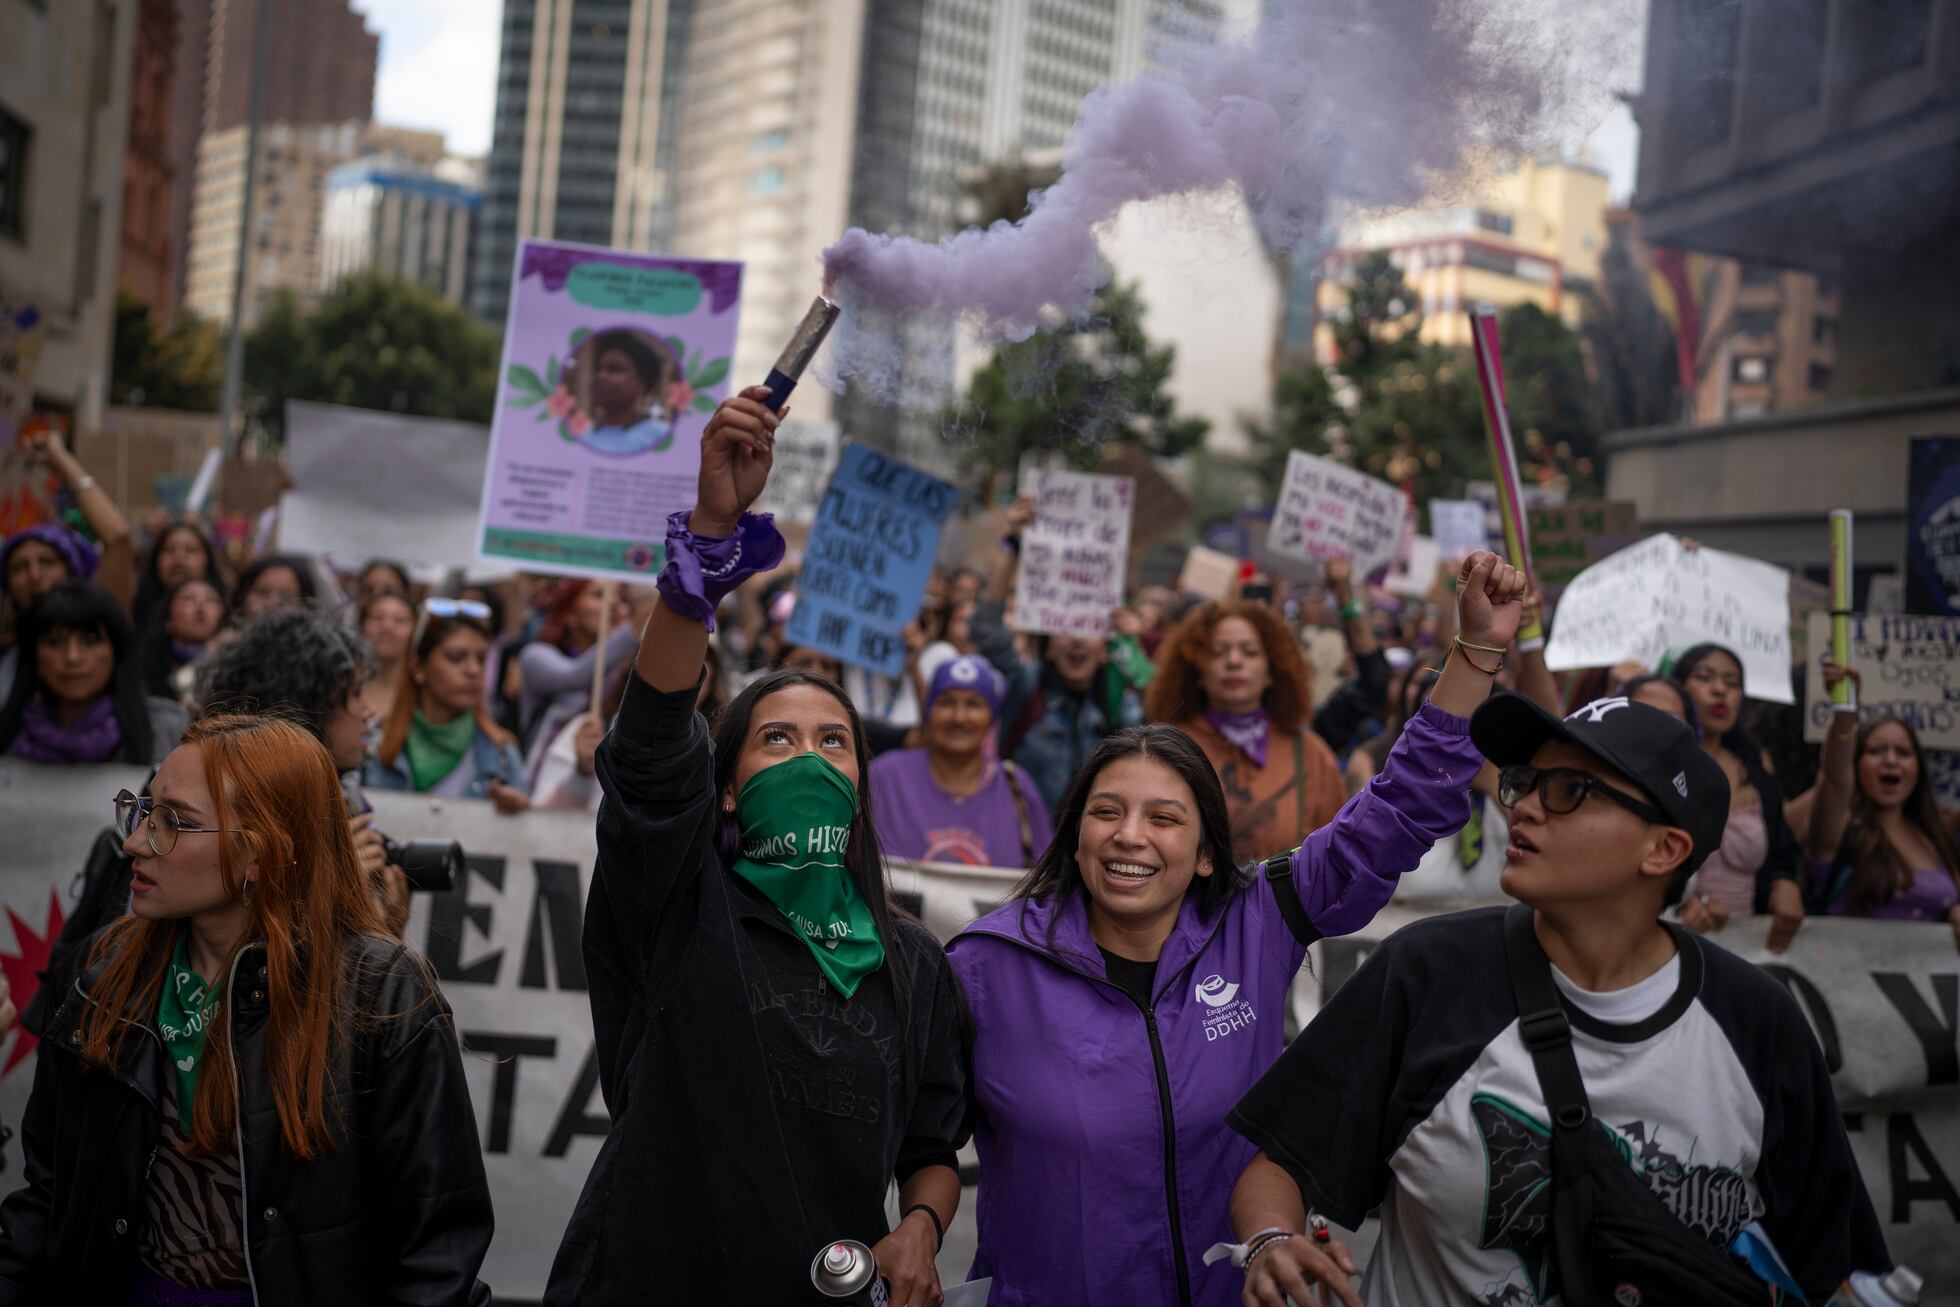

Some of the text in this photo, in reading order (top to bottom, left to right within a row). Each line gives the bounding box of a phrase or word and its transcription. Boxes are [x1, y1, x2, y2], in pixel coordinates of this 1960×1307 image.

[1202, 1001, 1250, 1028] Feminista de
[1206, 1000, 1240, 1017] Esquema
[1205, 1007, 1257, 1041] DDHH
